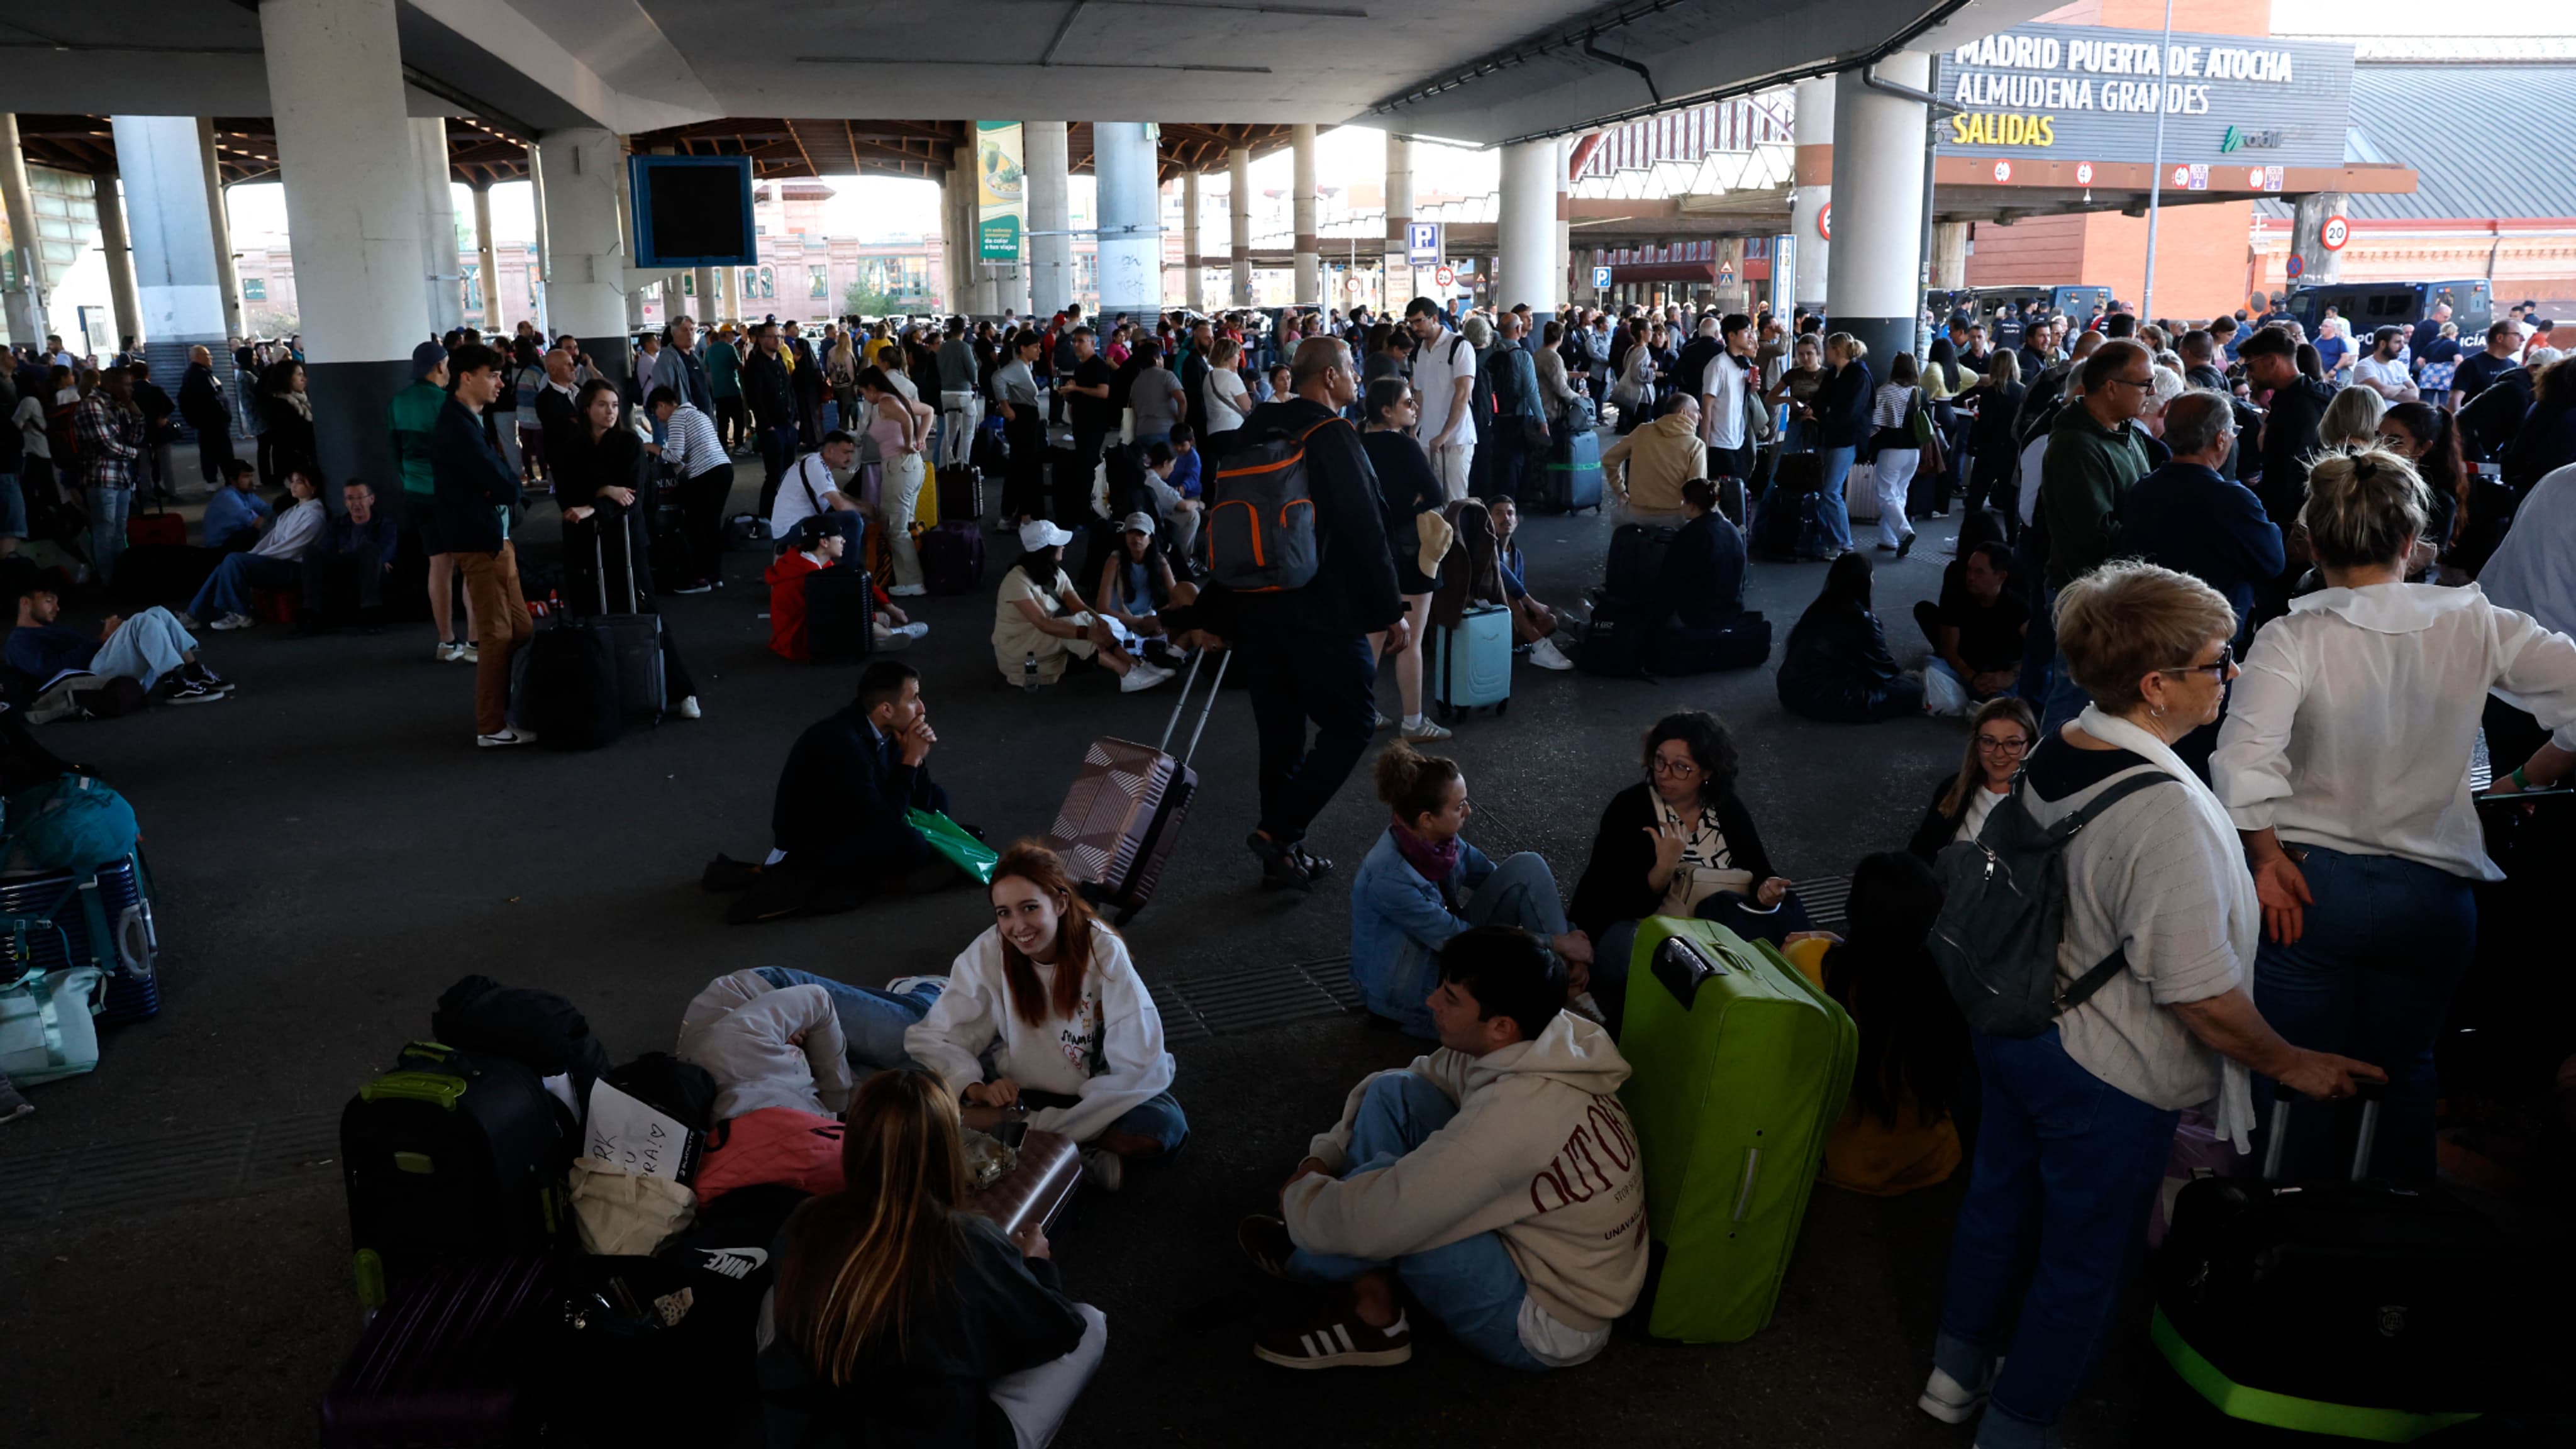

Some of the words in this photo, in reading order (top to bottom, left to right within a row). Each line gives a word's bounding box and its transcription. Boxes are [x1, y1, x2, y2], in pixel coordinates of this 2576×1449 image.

[1955, 34, 2060, 69] MADRID
[2067, 40, 2161, 75] PUERTA
[2167, 46, 2201, 76] DE
[2204, 48, 2292, 82] ATOCHA
[1955, 72, 2093, 109] ALMUDENA
[2101, 80, 2209, 114] GRANDES
[1952, 112, 2054, 146] SALIDAS
[2329, 228, 2344, 238] 20
[1596, 270, 1607, 285] P
[702, 1252, 755, 1280] NIKE
